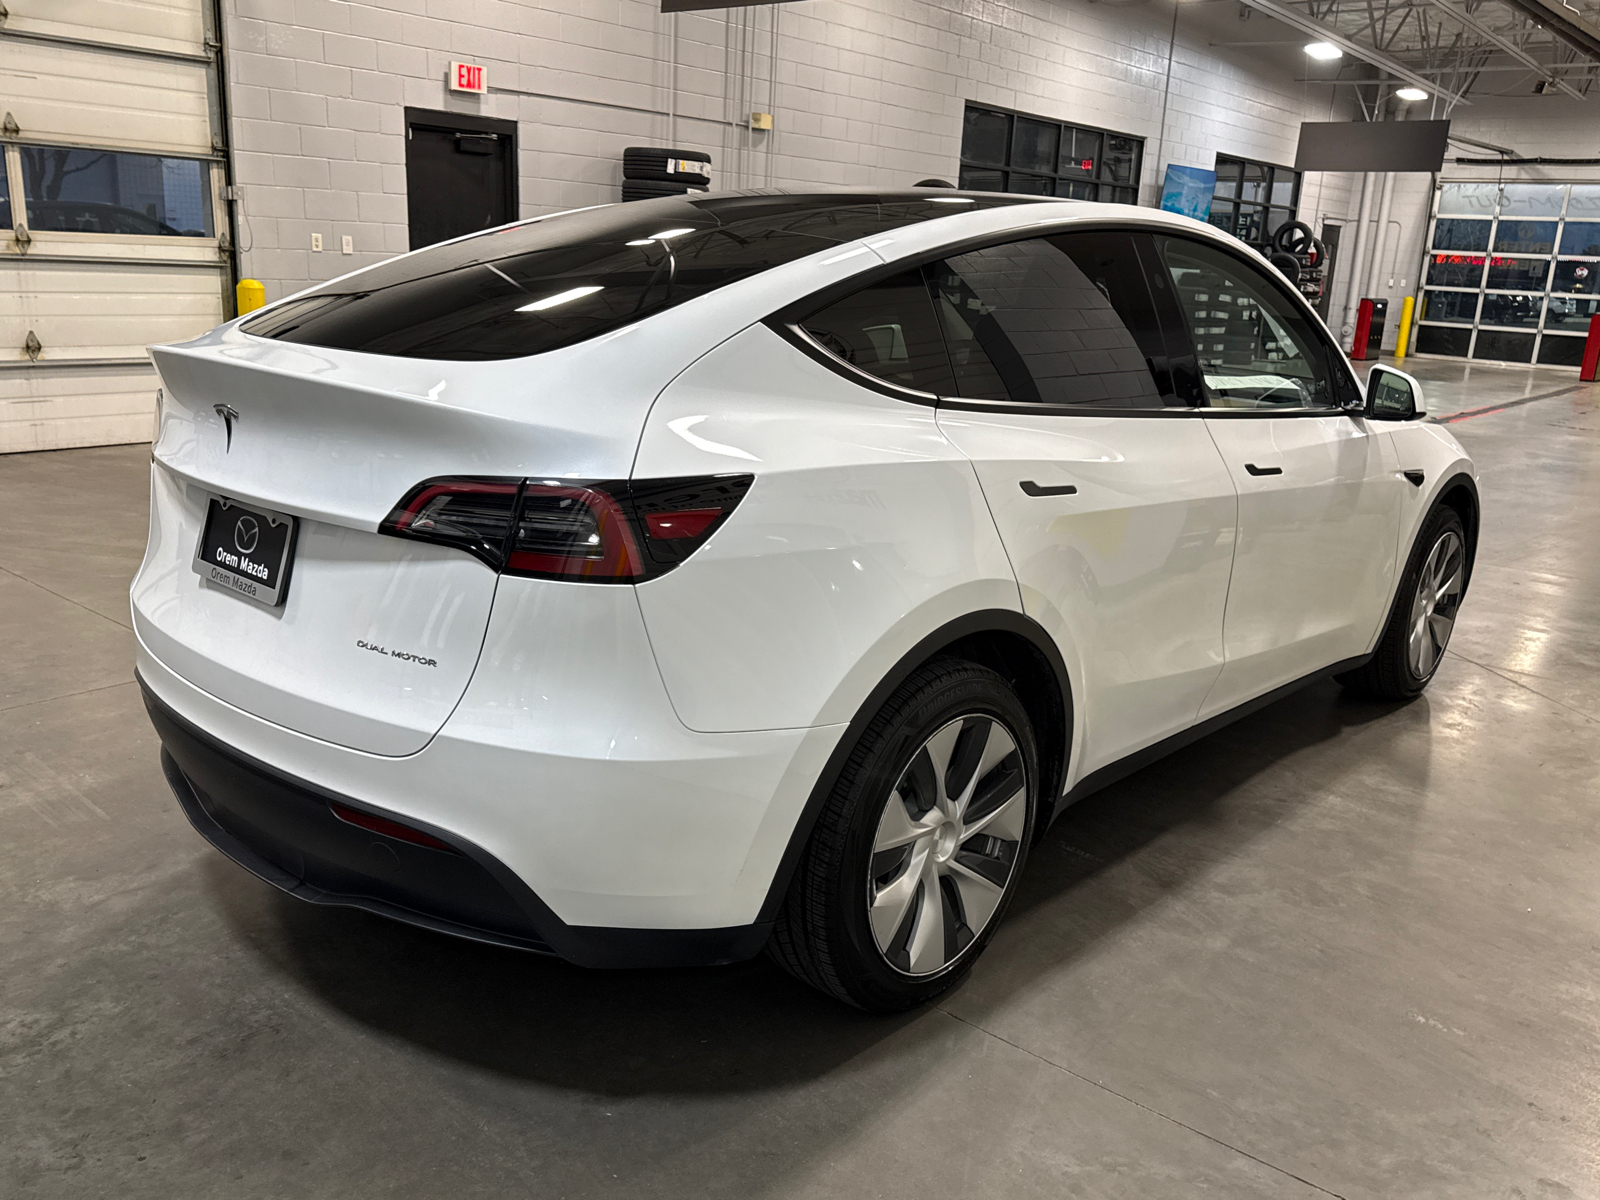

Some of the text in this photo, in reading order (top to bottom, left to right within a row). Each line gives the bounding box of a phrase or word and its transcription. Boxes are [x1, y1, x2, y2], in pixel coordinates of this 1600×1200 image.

[458, 64, 482, 91] EXIT
[216, 547, 269, 580] Orem Mazda
[211, 567, 257, 597] Orem Mazda
[356, 639, 437, 668] DUAL MOTOR
